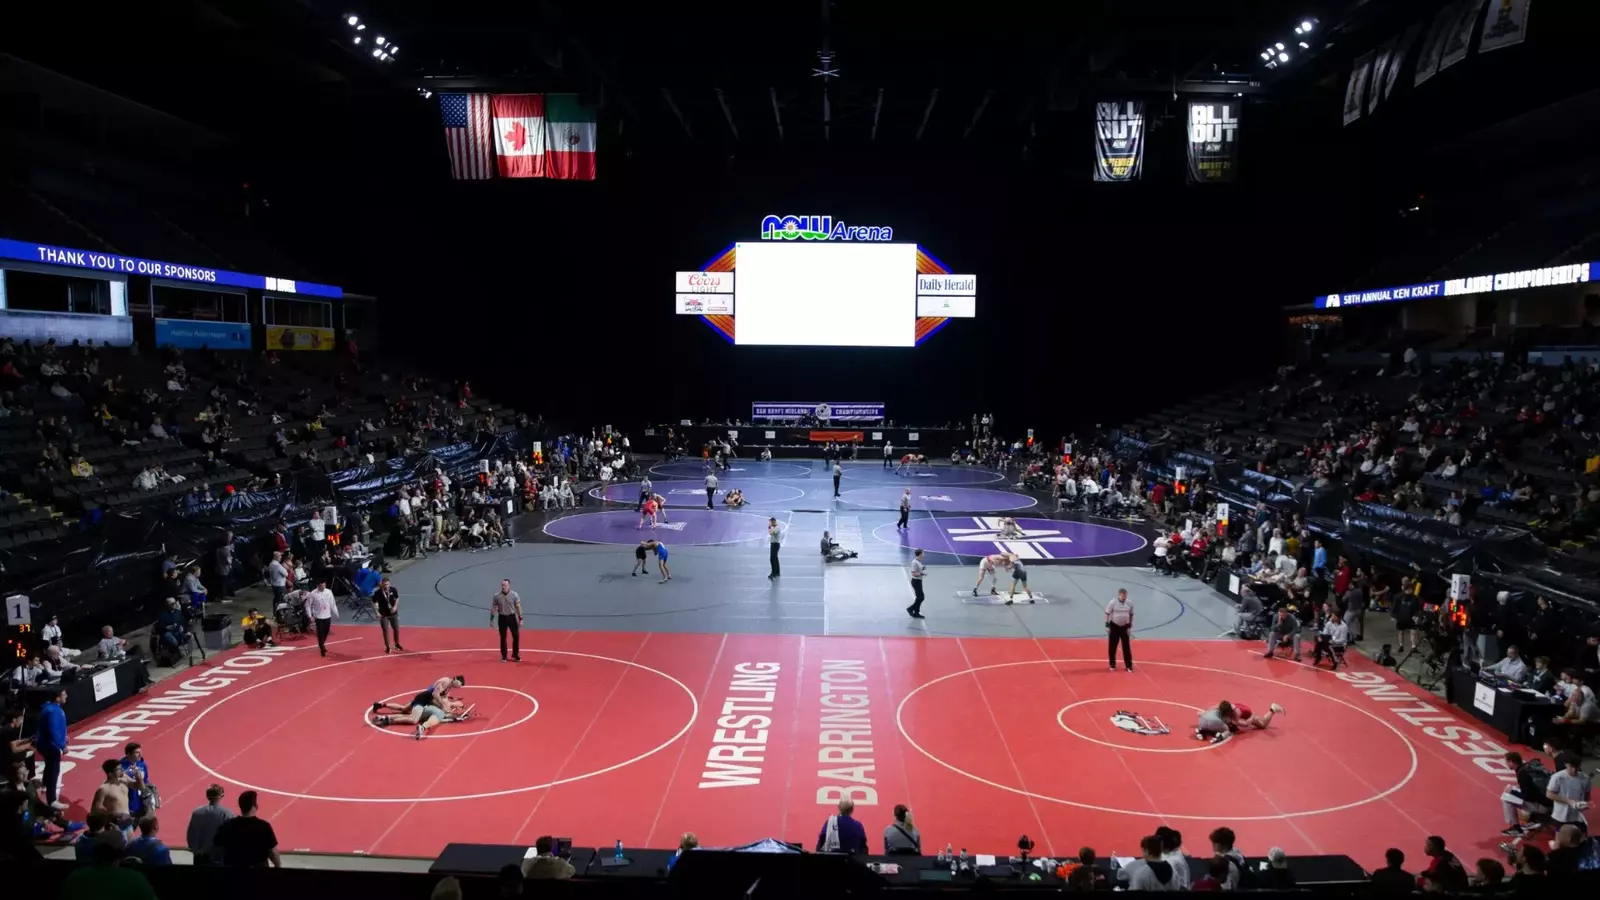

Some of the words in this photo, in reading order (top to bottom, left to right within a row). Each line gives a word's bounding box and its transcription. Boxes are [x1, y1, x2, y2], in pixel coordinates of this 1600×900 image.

[1191, 105, 1238, 124] ALL
[1191, 124, 1238, 143] OUT
[831, 221, 893, 241] Arena
[38, 247, 86, 265] THANK
[89, 254, 115, 269] YOU
[119, 258, 135, 272] TO
[138, 261, 162, 275] OUR
[164, 265, 216, 282] SPONSORS
[688, 273, 721, 286] Coors
[920, 279, 942, 291] Daily
[944, 279, 974, 291] Herald
[1361, 291, 1392, 303] ANNUAL
[1393, 288, 1410, 300] KEN
[1411, 284, 1440, 297] KRAFT
[1494, 263, 1590, 291] CHAMPIONSHIPS
[691, 286, 718, 294] LIGHT
[13, 603, 24, 620] 1
[698, 662, 781, 788] WRESTLING
[816, 659, 879, 806] BARRINGTON
[1335, 671, 1519, 782] RESTLING
